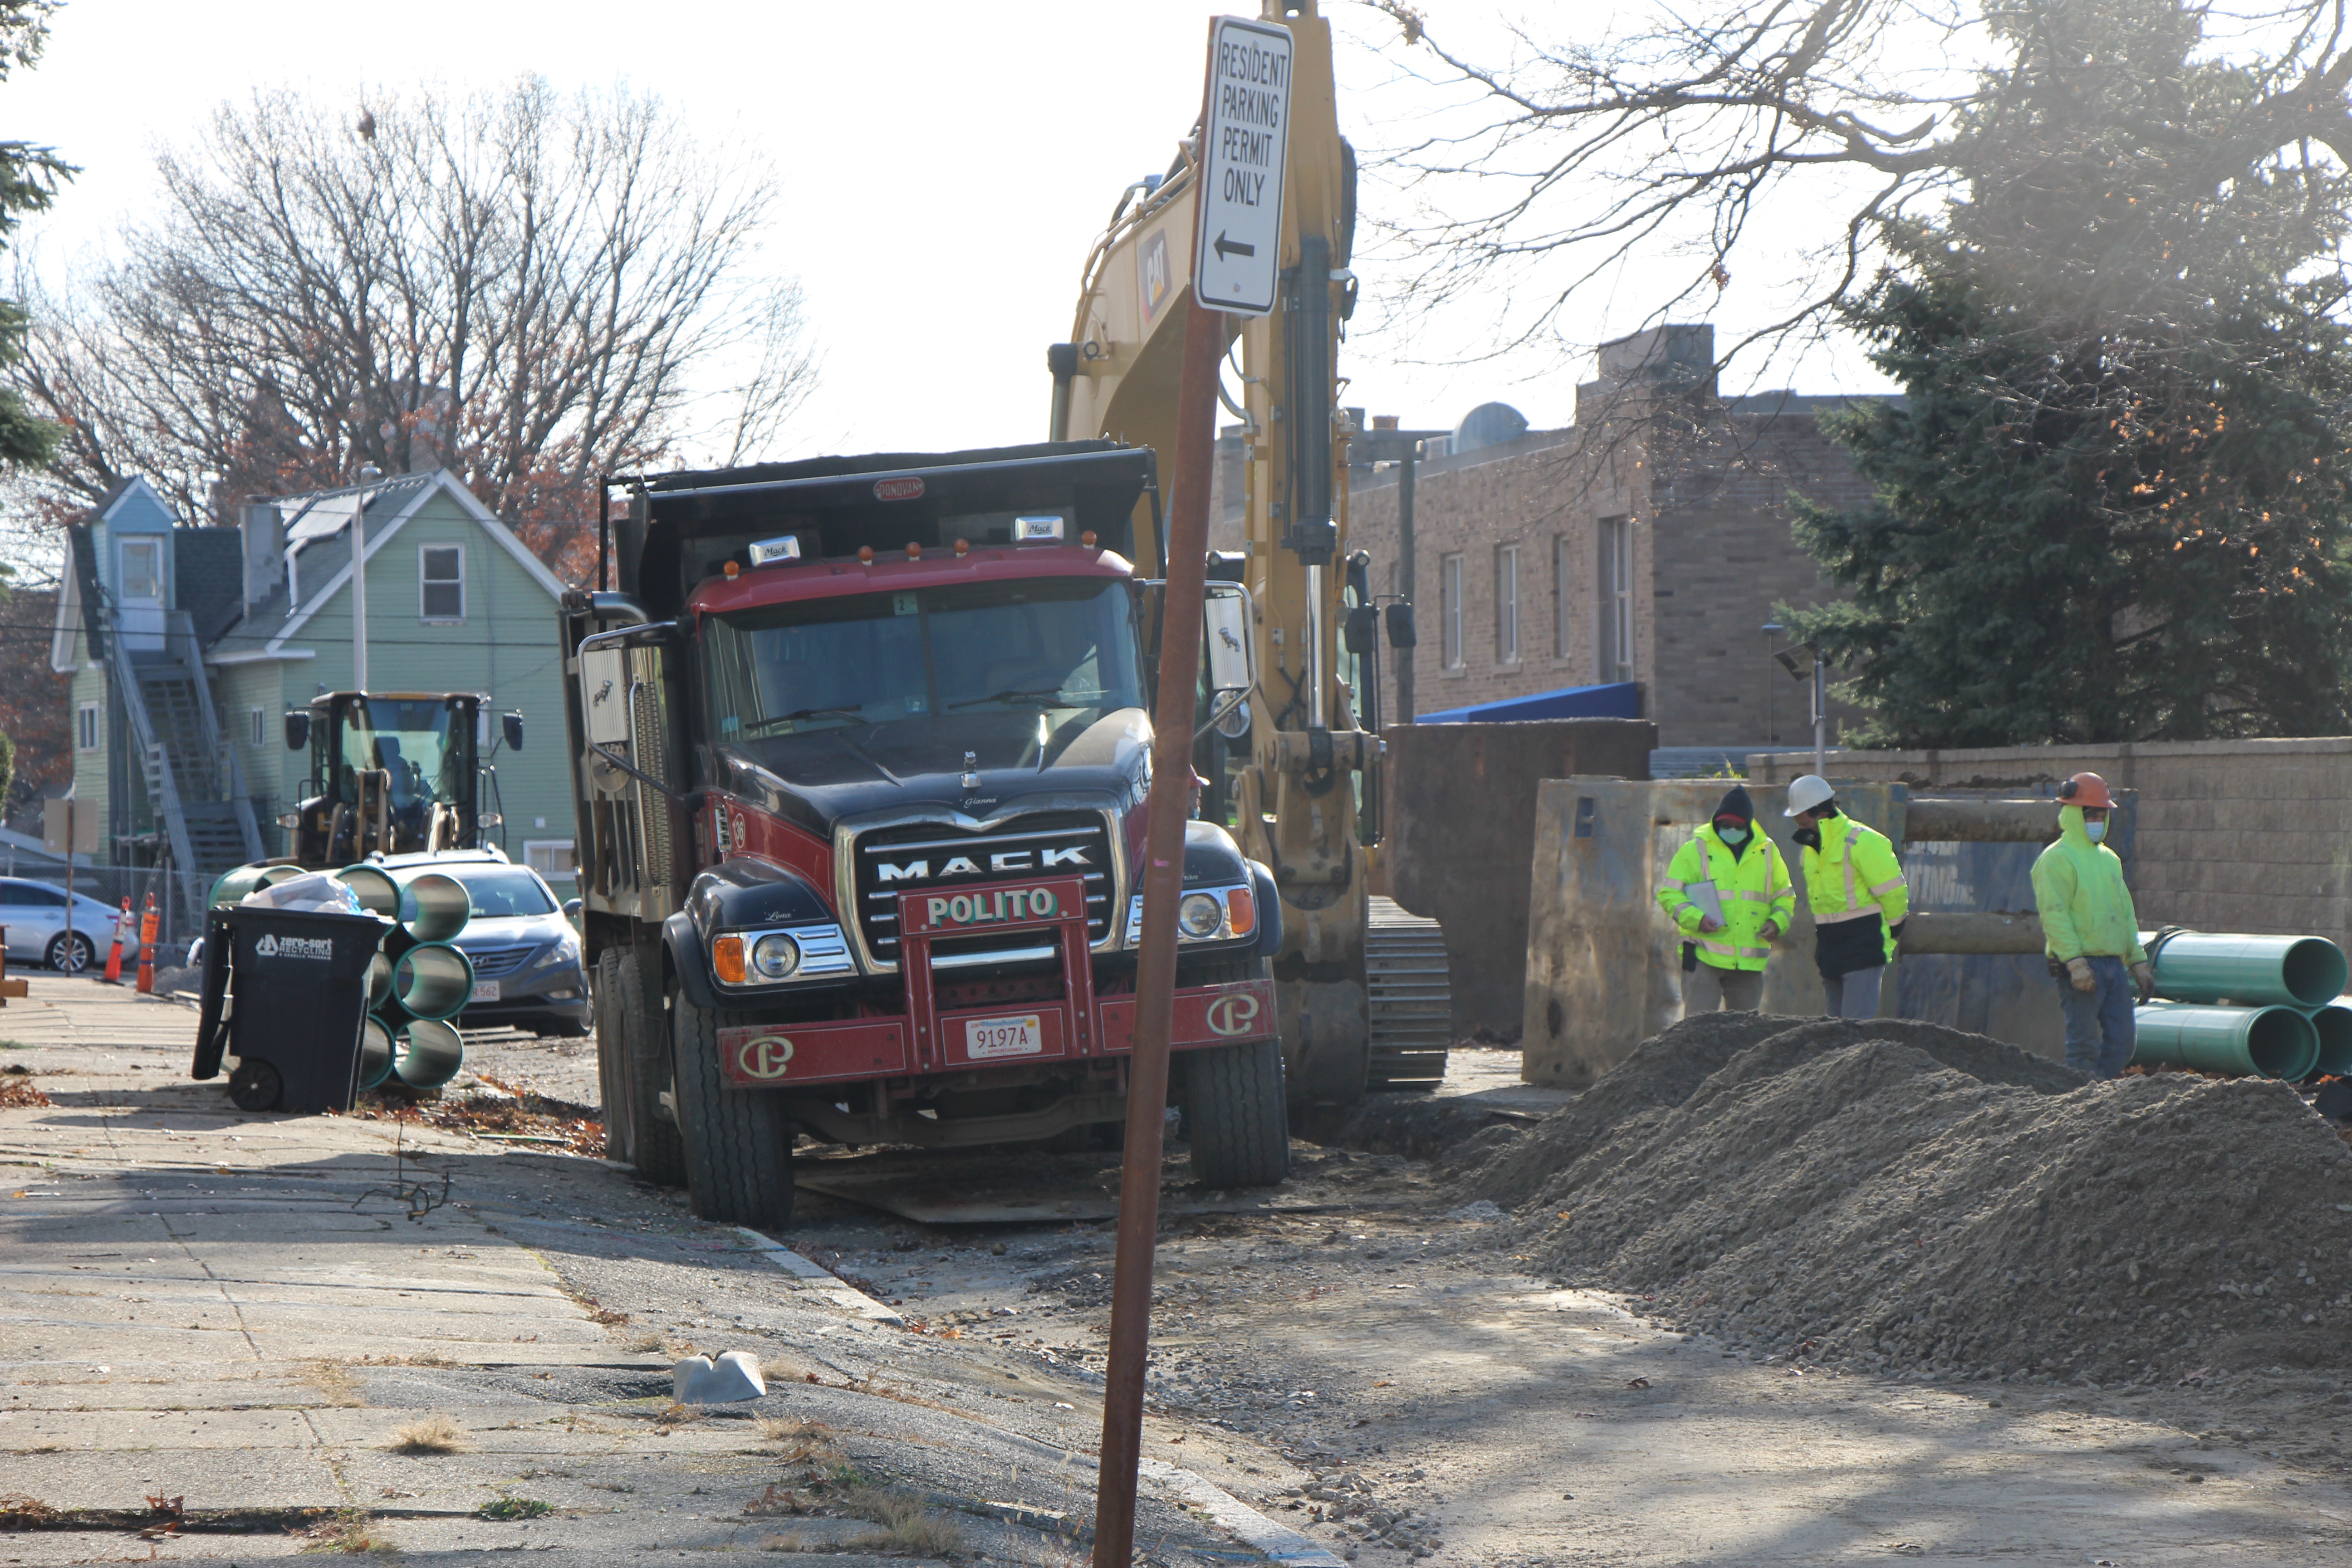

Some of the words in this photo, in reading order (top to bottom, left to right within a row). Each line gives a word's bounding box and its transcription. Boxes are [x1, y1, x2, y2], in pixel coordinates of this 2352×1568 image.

[1220, 41, 1287, 88] RESIDENT
[1221, 84, 1279, 128] PARKING
[1222, 127, 1272, 167] PERMIT
[1224, 167, 1265, 206] ONLY
[1147, 239, 1165, 307] CAT
[880, 481, 919, 496] DONOVAN
[1029, 524, 1052, 534] Mack
[764, 545, 787, 556] Mack
[735, 820, 744, 840] 36
[877, 845, 1093, 882] MACK
[927, 887, 1058, 928] POLITO
[279, 936, 332, 950] zero-sort
[279, 945, 332, 956] RECYCLING
[480, 986, 496, 997] 562
[976, 1026, 1028, 1049] 9197A
